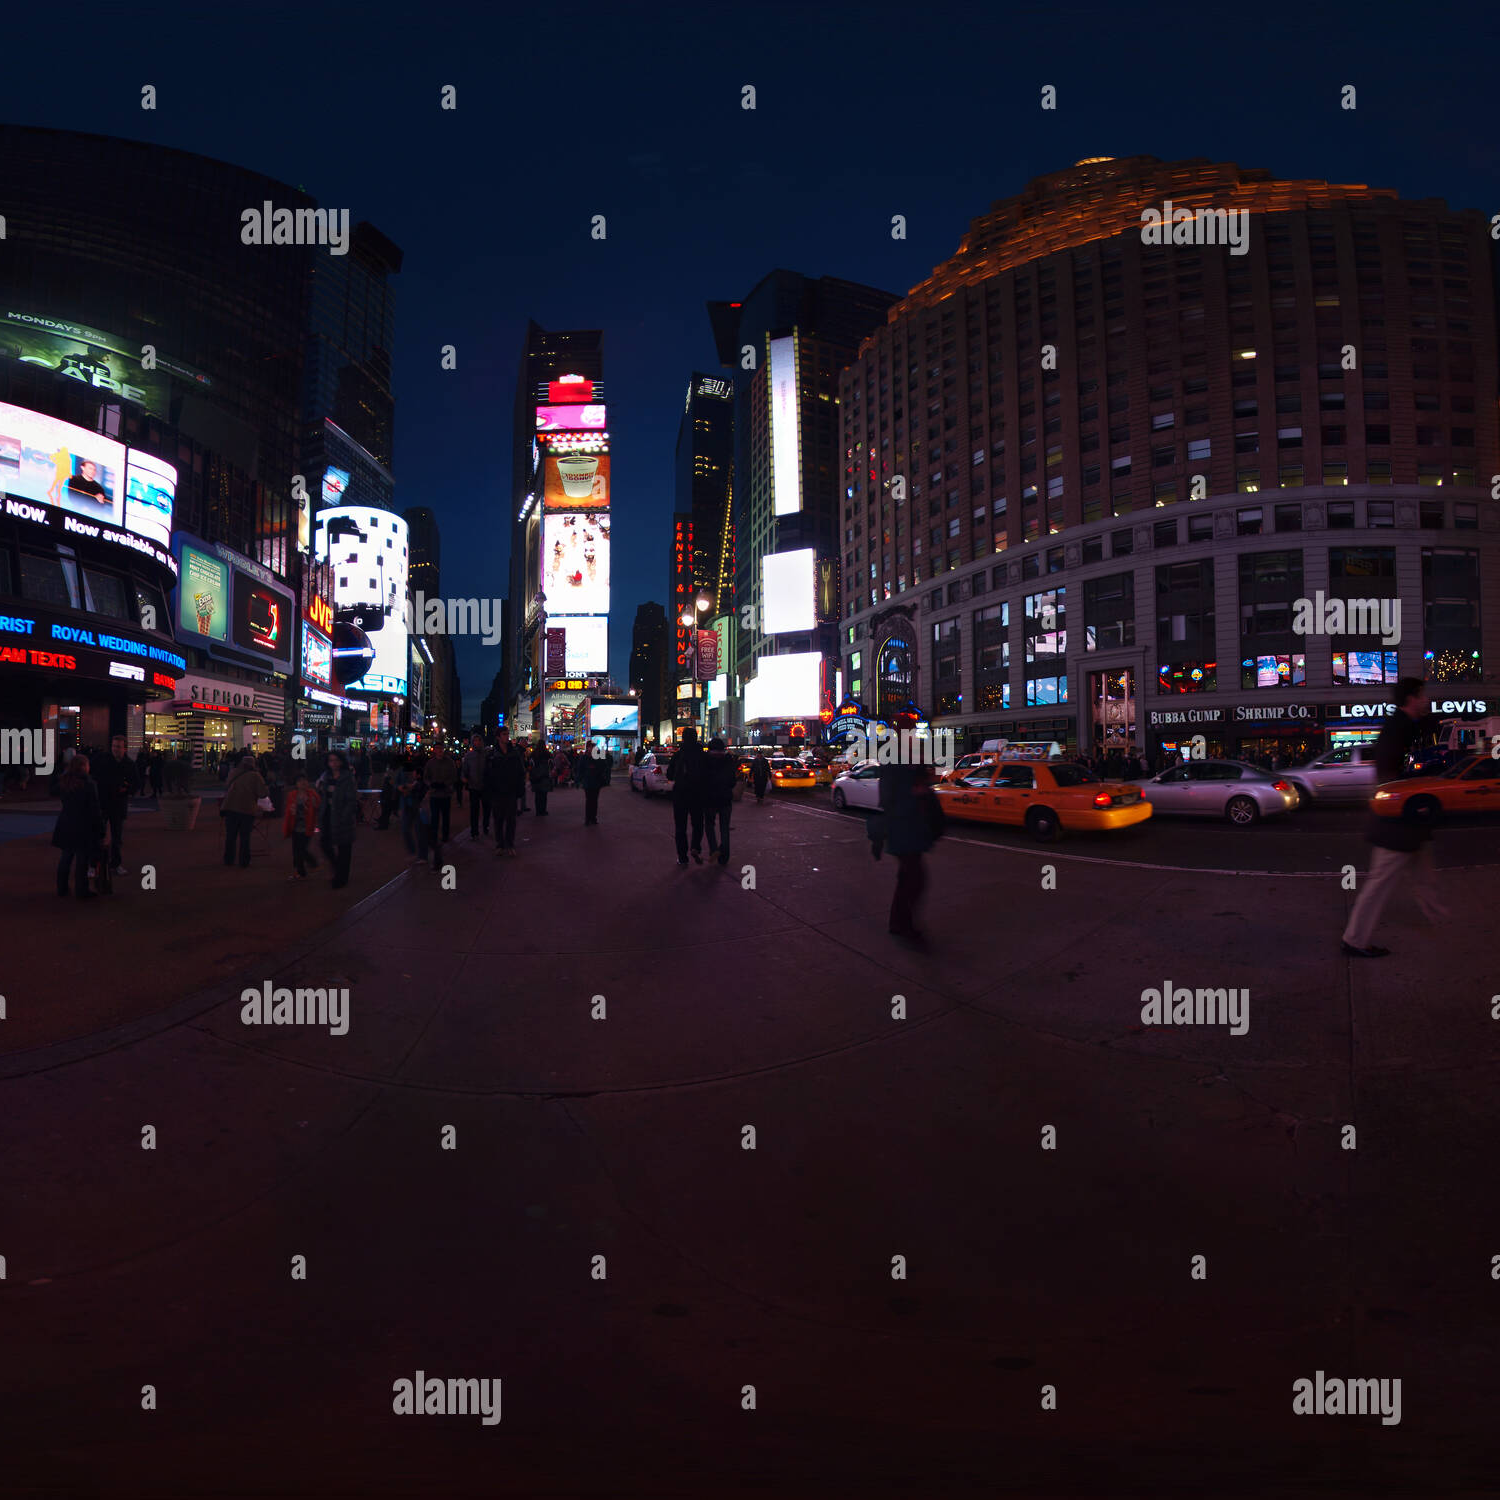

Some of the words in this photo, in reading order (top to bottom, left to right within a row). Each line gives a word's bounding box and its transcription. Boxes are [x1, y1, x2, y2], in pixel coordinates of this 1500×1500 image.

[8, 311, 82, 335] MONDAYS
[67, 358, 110, 378] THE
[6, 501, 50, 525] NOW.
[64, 517, 100, 537] Now
[102, 529, 155, 557] available
[156, 549, 168, 565] on
[676, 522, 684, 574] ERNST
[676, 583, 684, 593] &
[310, 595, 333, 635] JVC
[52, 624, 96, 646] ROYAL
[98, 633, 148, 657] WEDDING
[676, 603, 686, 666] YOUNG
[28, 650, 77, 670] TEXTS
[191, 685, 258, 709] SEPHORA
[1150, 711, 1186, 726] BUBBA
[1187, 709, 1221, 723] GUMP
[1236, 705, 1285, 722] SHRIMP
[1287, 704, 1311, 719] CO.
